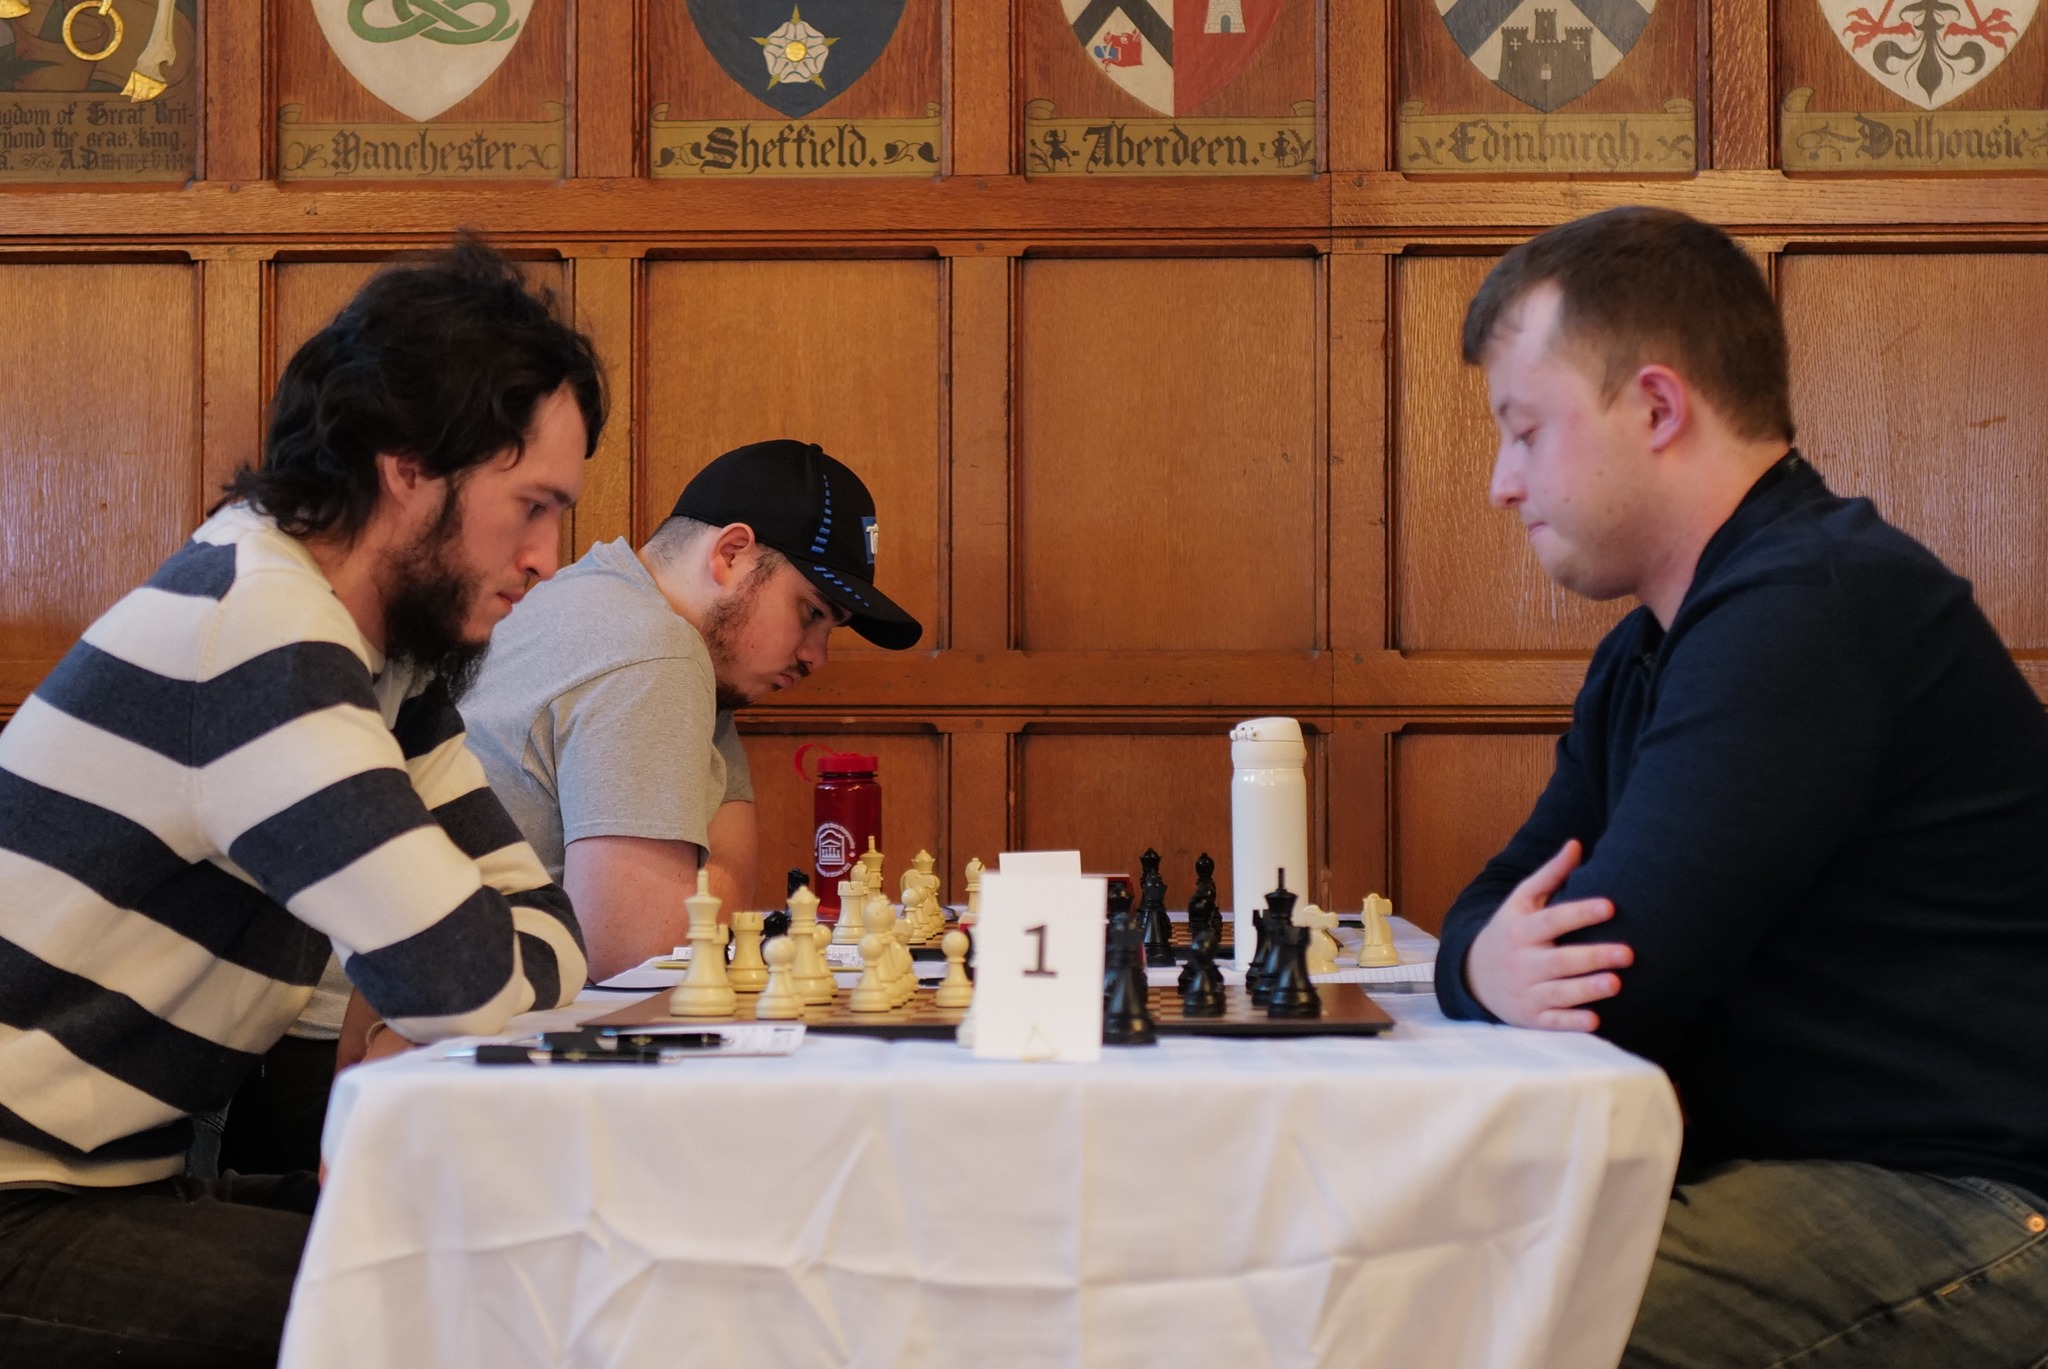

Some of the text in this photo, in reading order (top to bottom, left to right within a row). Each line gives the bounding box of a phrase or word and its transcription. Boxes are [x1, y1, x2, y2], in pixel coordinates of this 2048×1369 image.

[87, 101, 146, 127] Great
[330, 127, 524, 177] Manchester.
[700, 123, 877, 174] Sheffield.
[1082, 120, 1260, 174] Aberdeen.
[1448, 118, 1654, 172] Edinburgh.
[1022, 923, 1058, 979] 1
